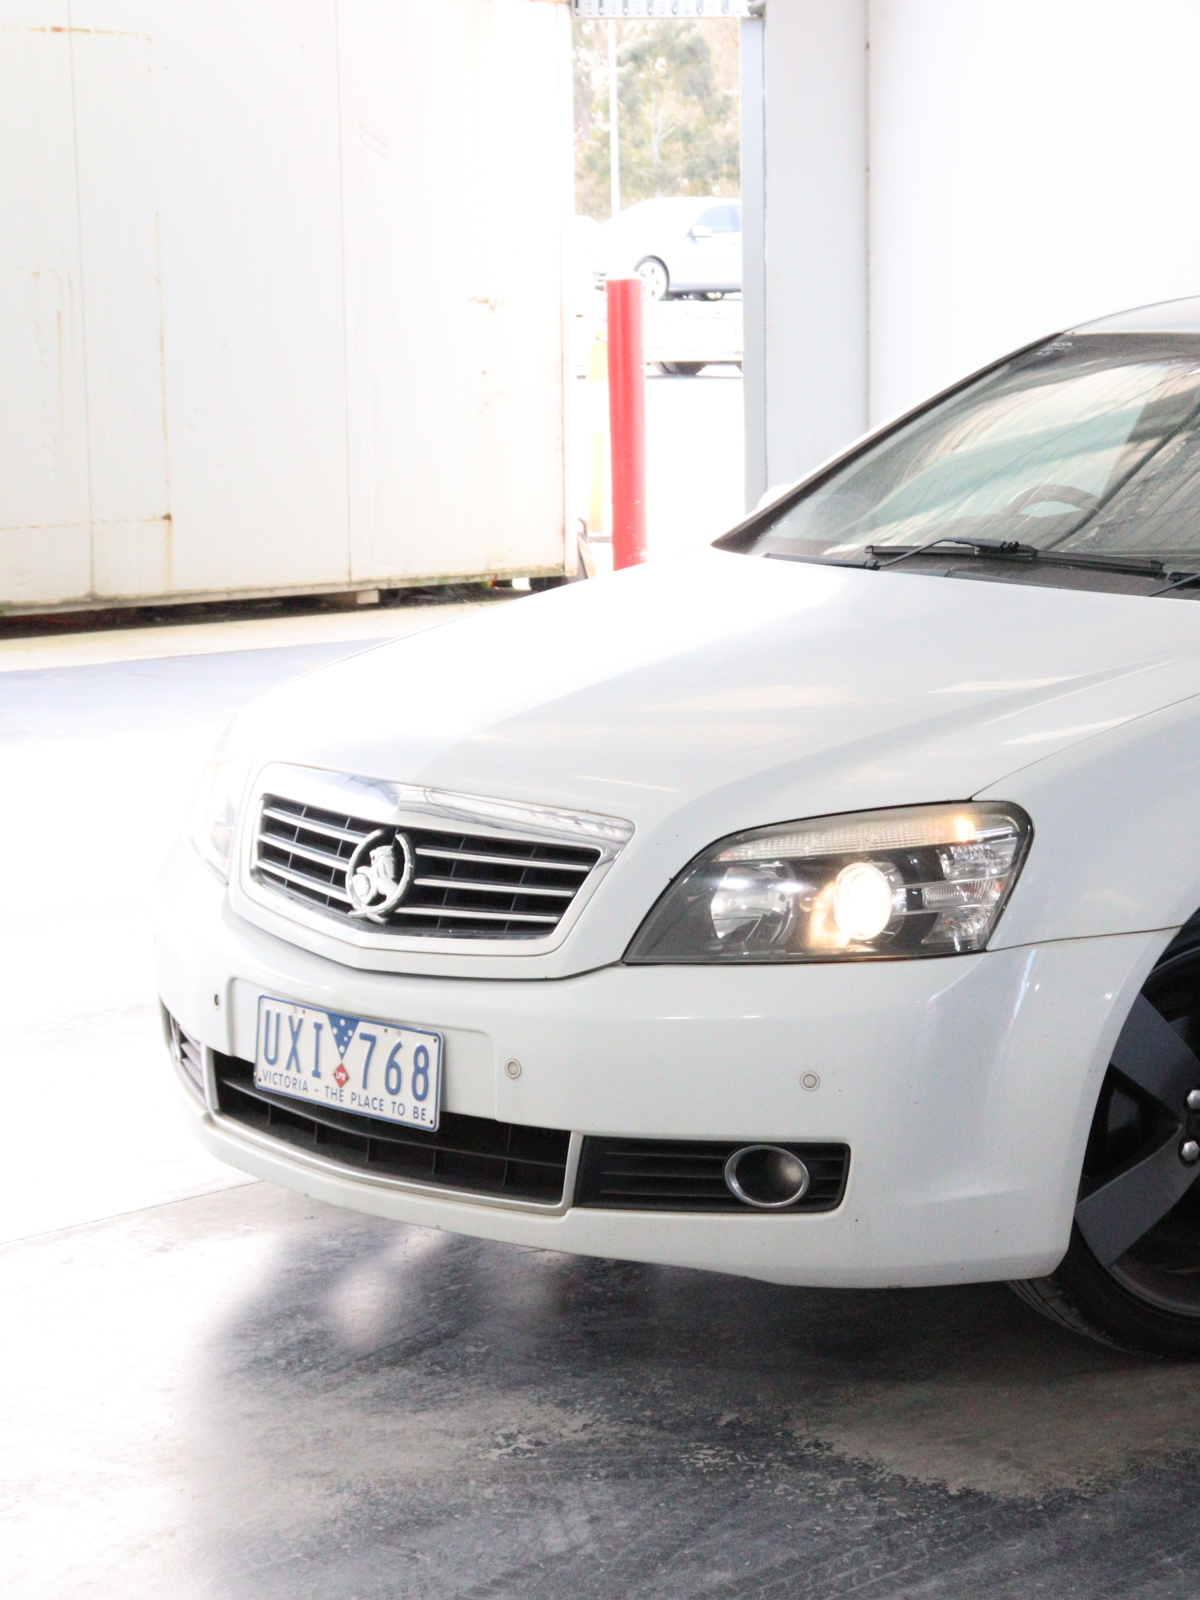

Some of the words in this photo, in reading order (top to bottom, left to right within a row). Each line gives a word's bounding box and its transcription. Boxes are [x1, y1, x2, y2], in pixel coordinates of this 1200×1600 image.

[263, 1009, 324, 1079] UXI
[359, 1032, 430, 1102] 768
[262, 1069, 309, 1093] VICTORIA
[325, 1085, 344, 1103] THE
[351, 1092, 384, 1112] PLACE
[391, 1101, 406, 1116] TO
[413, 1106, 427, 1121] BE
